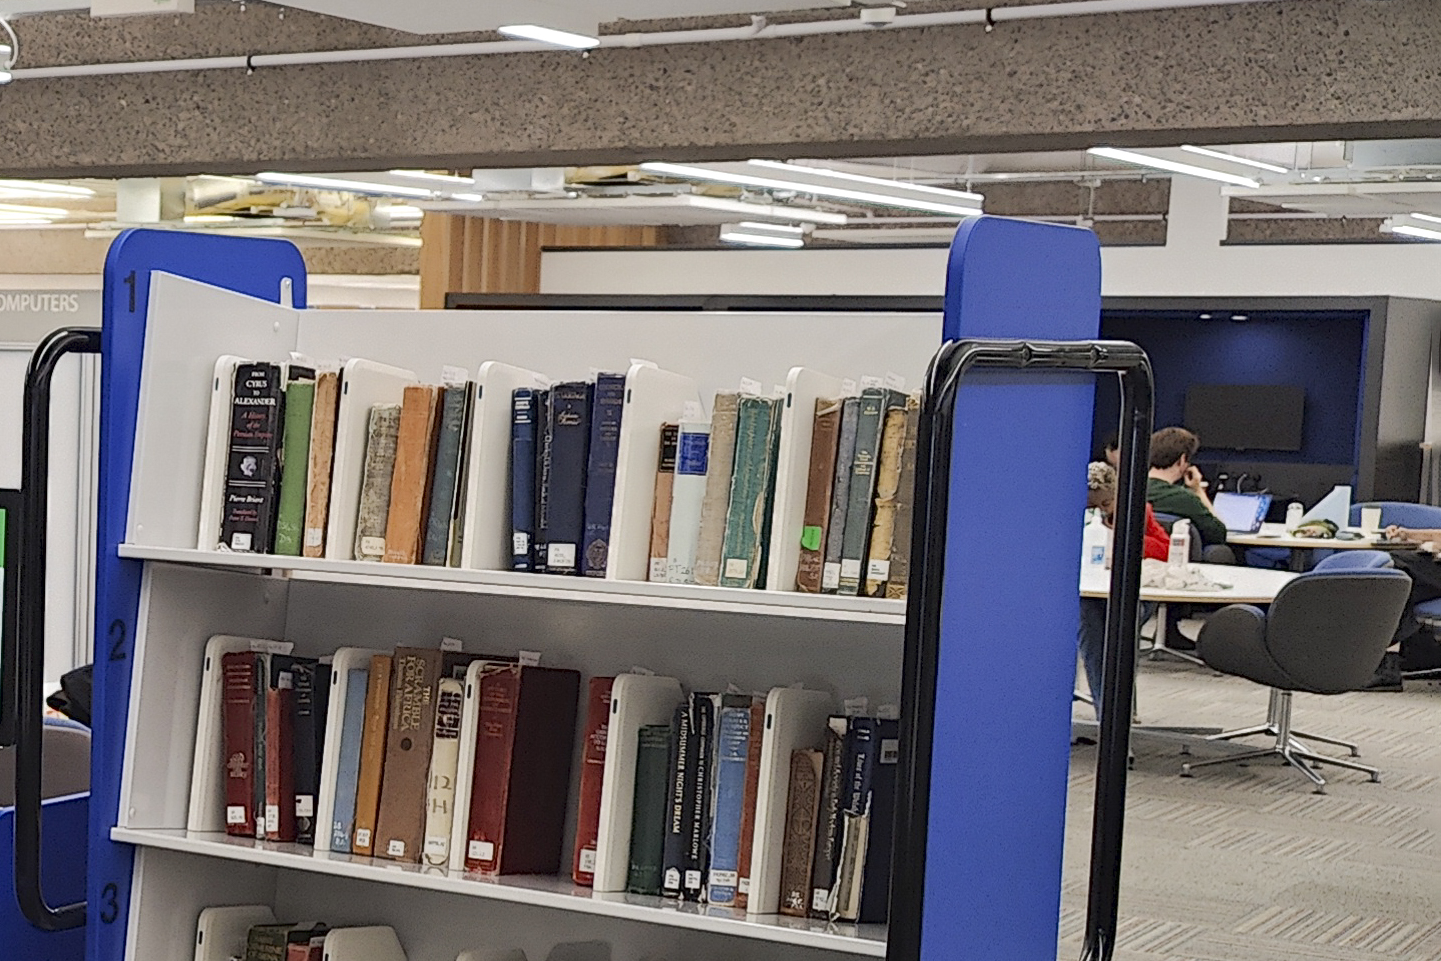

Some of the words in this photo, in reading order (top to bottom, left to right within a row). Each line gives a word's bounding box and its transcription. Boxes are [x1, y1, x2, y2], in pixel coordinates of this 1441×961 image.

[123, 270, 136, 313] 1
[234, 397, 276, 406] ALEXANDER
[245, 380, 268, 388] CYRUS
[109, 619, 127, 661] 2
[405, 656, 416, 682] FOR
[401, 683, 413, 732] AFRICA
[411, 659, 426, 730] SCRAMBLE
[422, 686, 431, 705] THE
[677, 719, 688, 771] MIDSUMMER
[694, 766, 705, 820] CHRISTOPHER
[672, 804, 682, 834] DREAM
[691, 822, 701, 860] MARLOWE
[100, 882, 119, 924] 3
